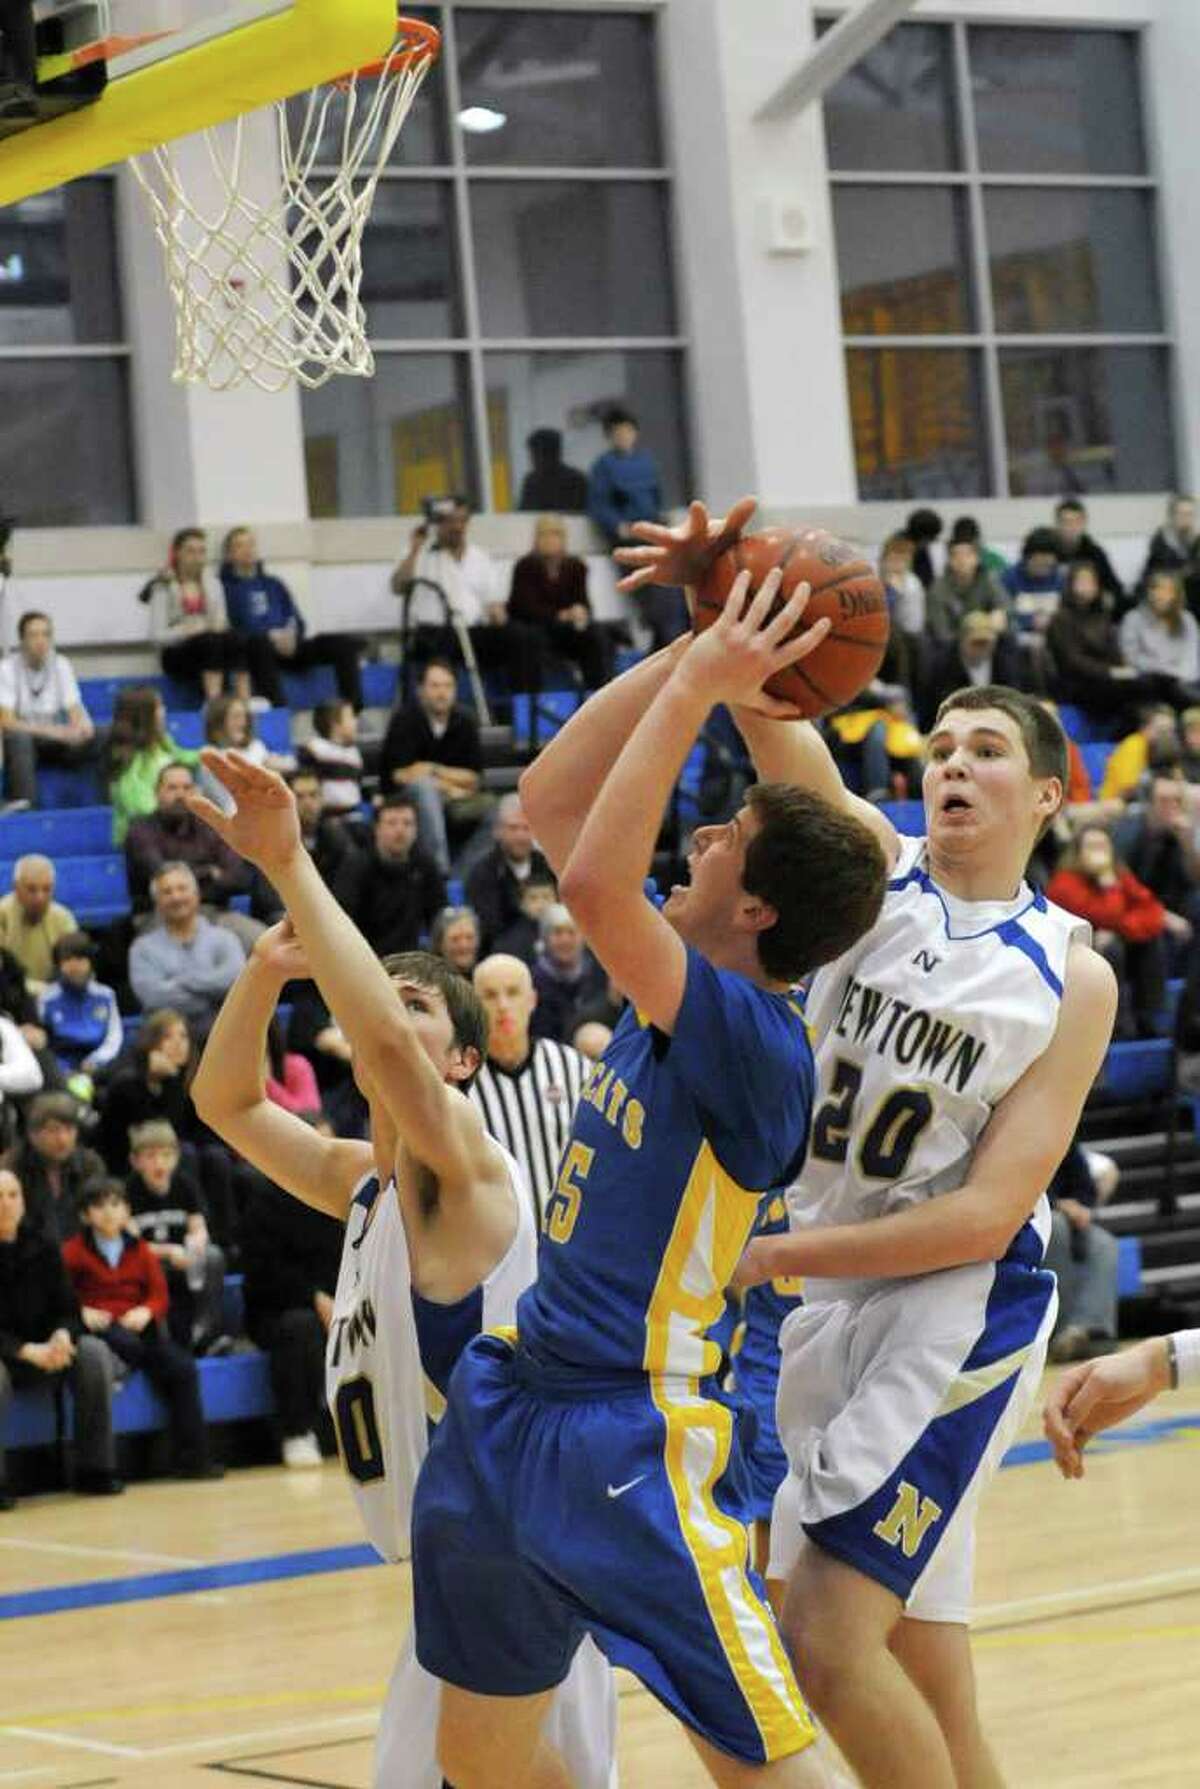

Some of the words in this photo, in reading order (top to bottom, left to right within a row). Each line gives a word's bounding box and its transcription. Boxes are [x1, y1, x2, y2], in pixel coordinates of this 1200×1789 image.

[911, 949, 942, 973] N
[836, 975, 987, 1094] EWTOWN
[809, 1055, 934, 1181] 20
[543, 1139, 596, 1245] 5
[872, 1480, 942, 1558] N
